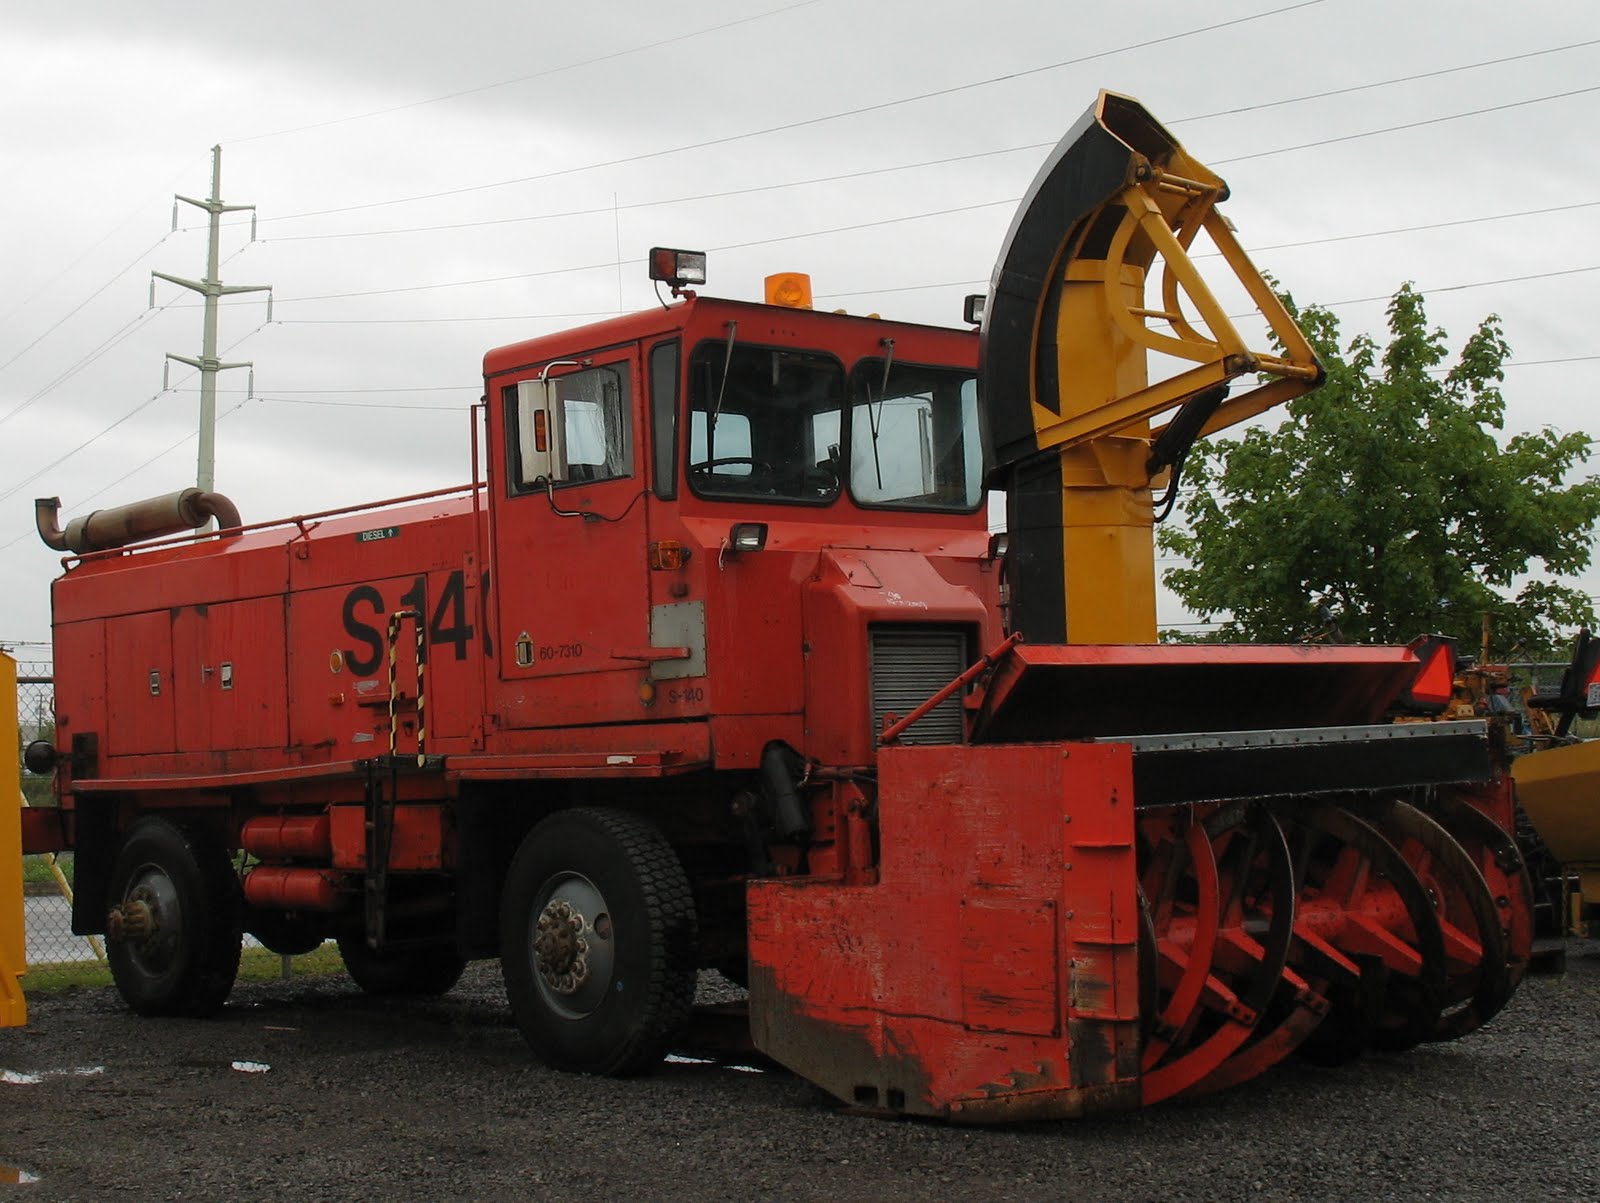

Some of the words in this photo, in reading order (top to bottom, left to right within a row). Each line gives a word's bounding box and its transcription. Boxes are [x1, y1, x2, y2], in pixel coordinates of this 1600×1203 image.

[362, 529, 386, 542] DIESEL
[540, 643, 583, 660] 60-7310
[668, 687, 704, 704] S-140
